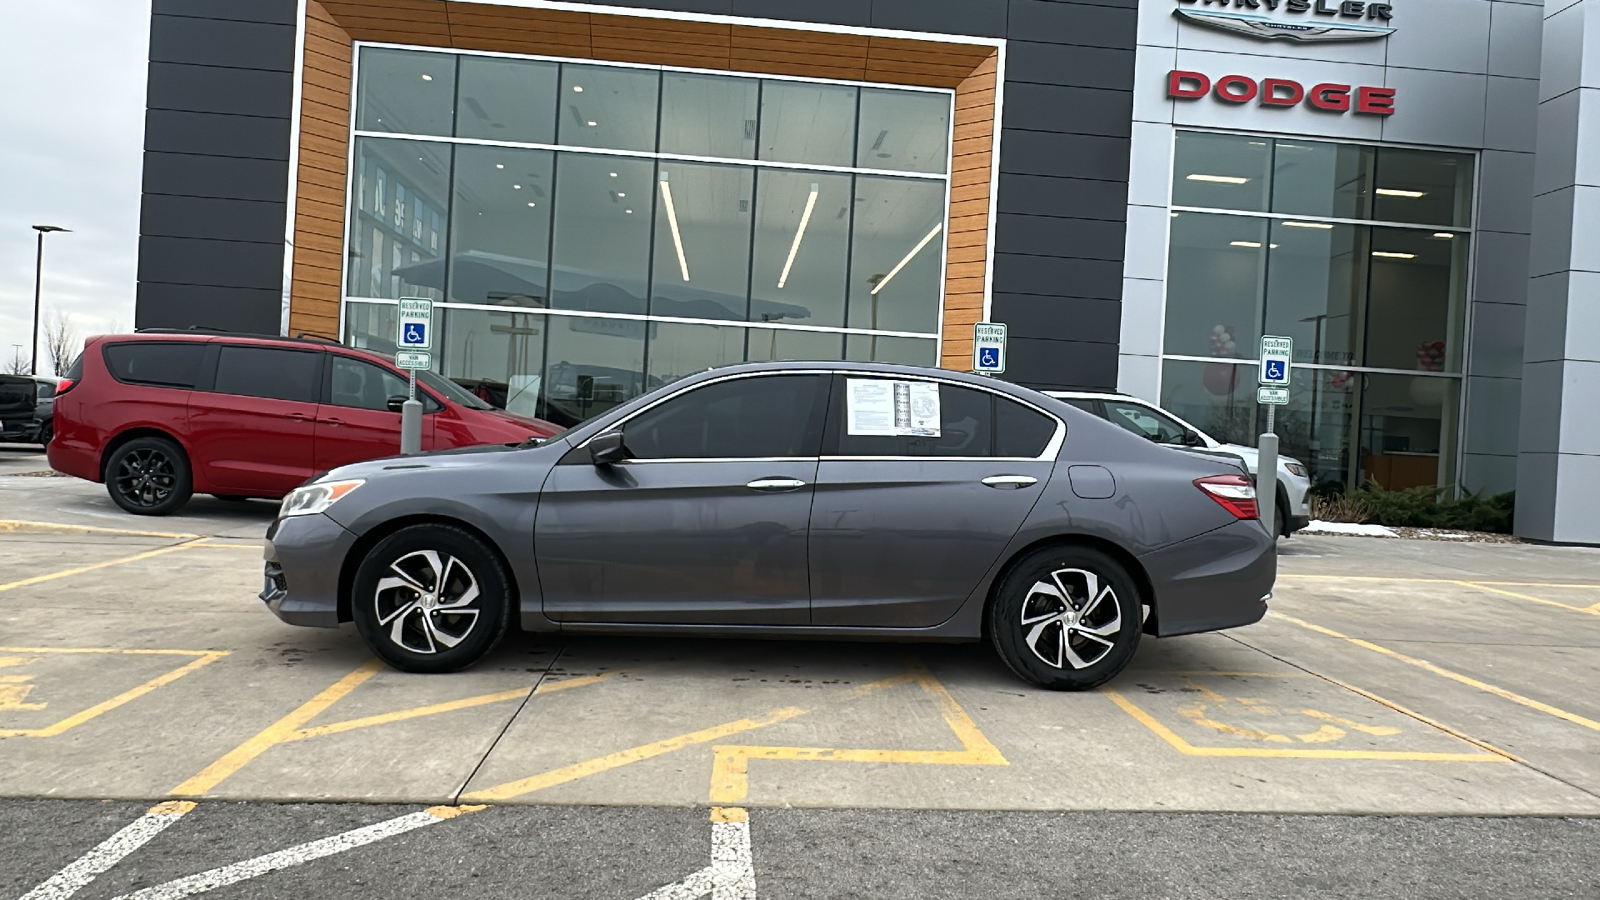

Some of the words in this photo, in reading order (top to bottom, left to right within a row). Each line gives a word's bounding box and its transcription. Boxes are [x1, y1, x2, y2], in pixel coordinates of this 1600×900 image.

[1167, 70, 1396, 115] DODGE
[401, 302, 430, 310] RESERVED
[401, 311, 430, 319] PARKING
[977, 327, 1004, 336] RESERVED
[976, 336, 1003, 344] PARKING
[1264, 340, 1289, 349] RESERVED
[1263, 348, 1289, 357] PARKING
